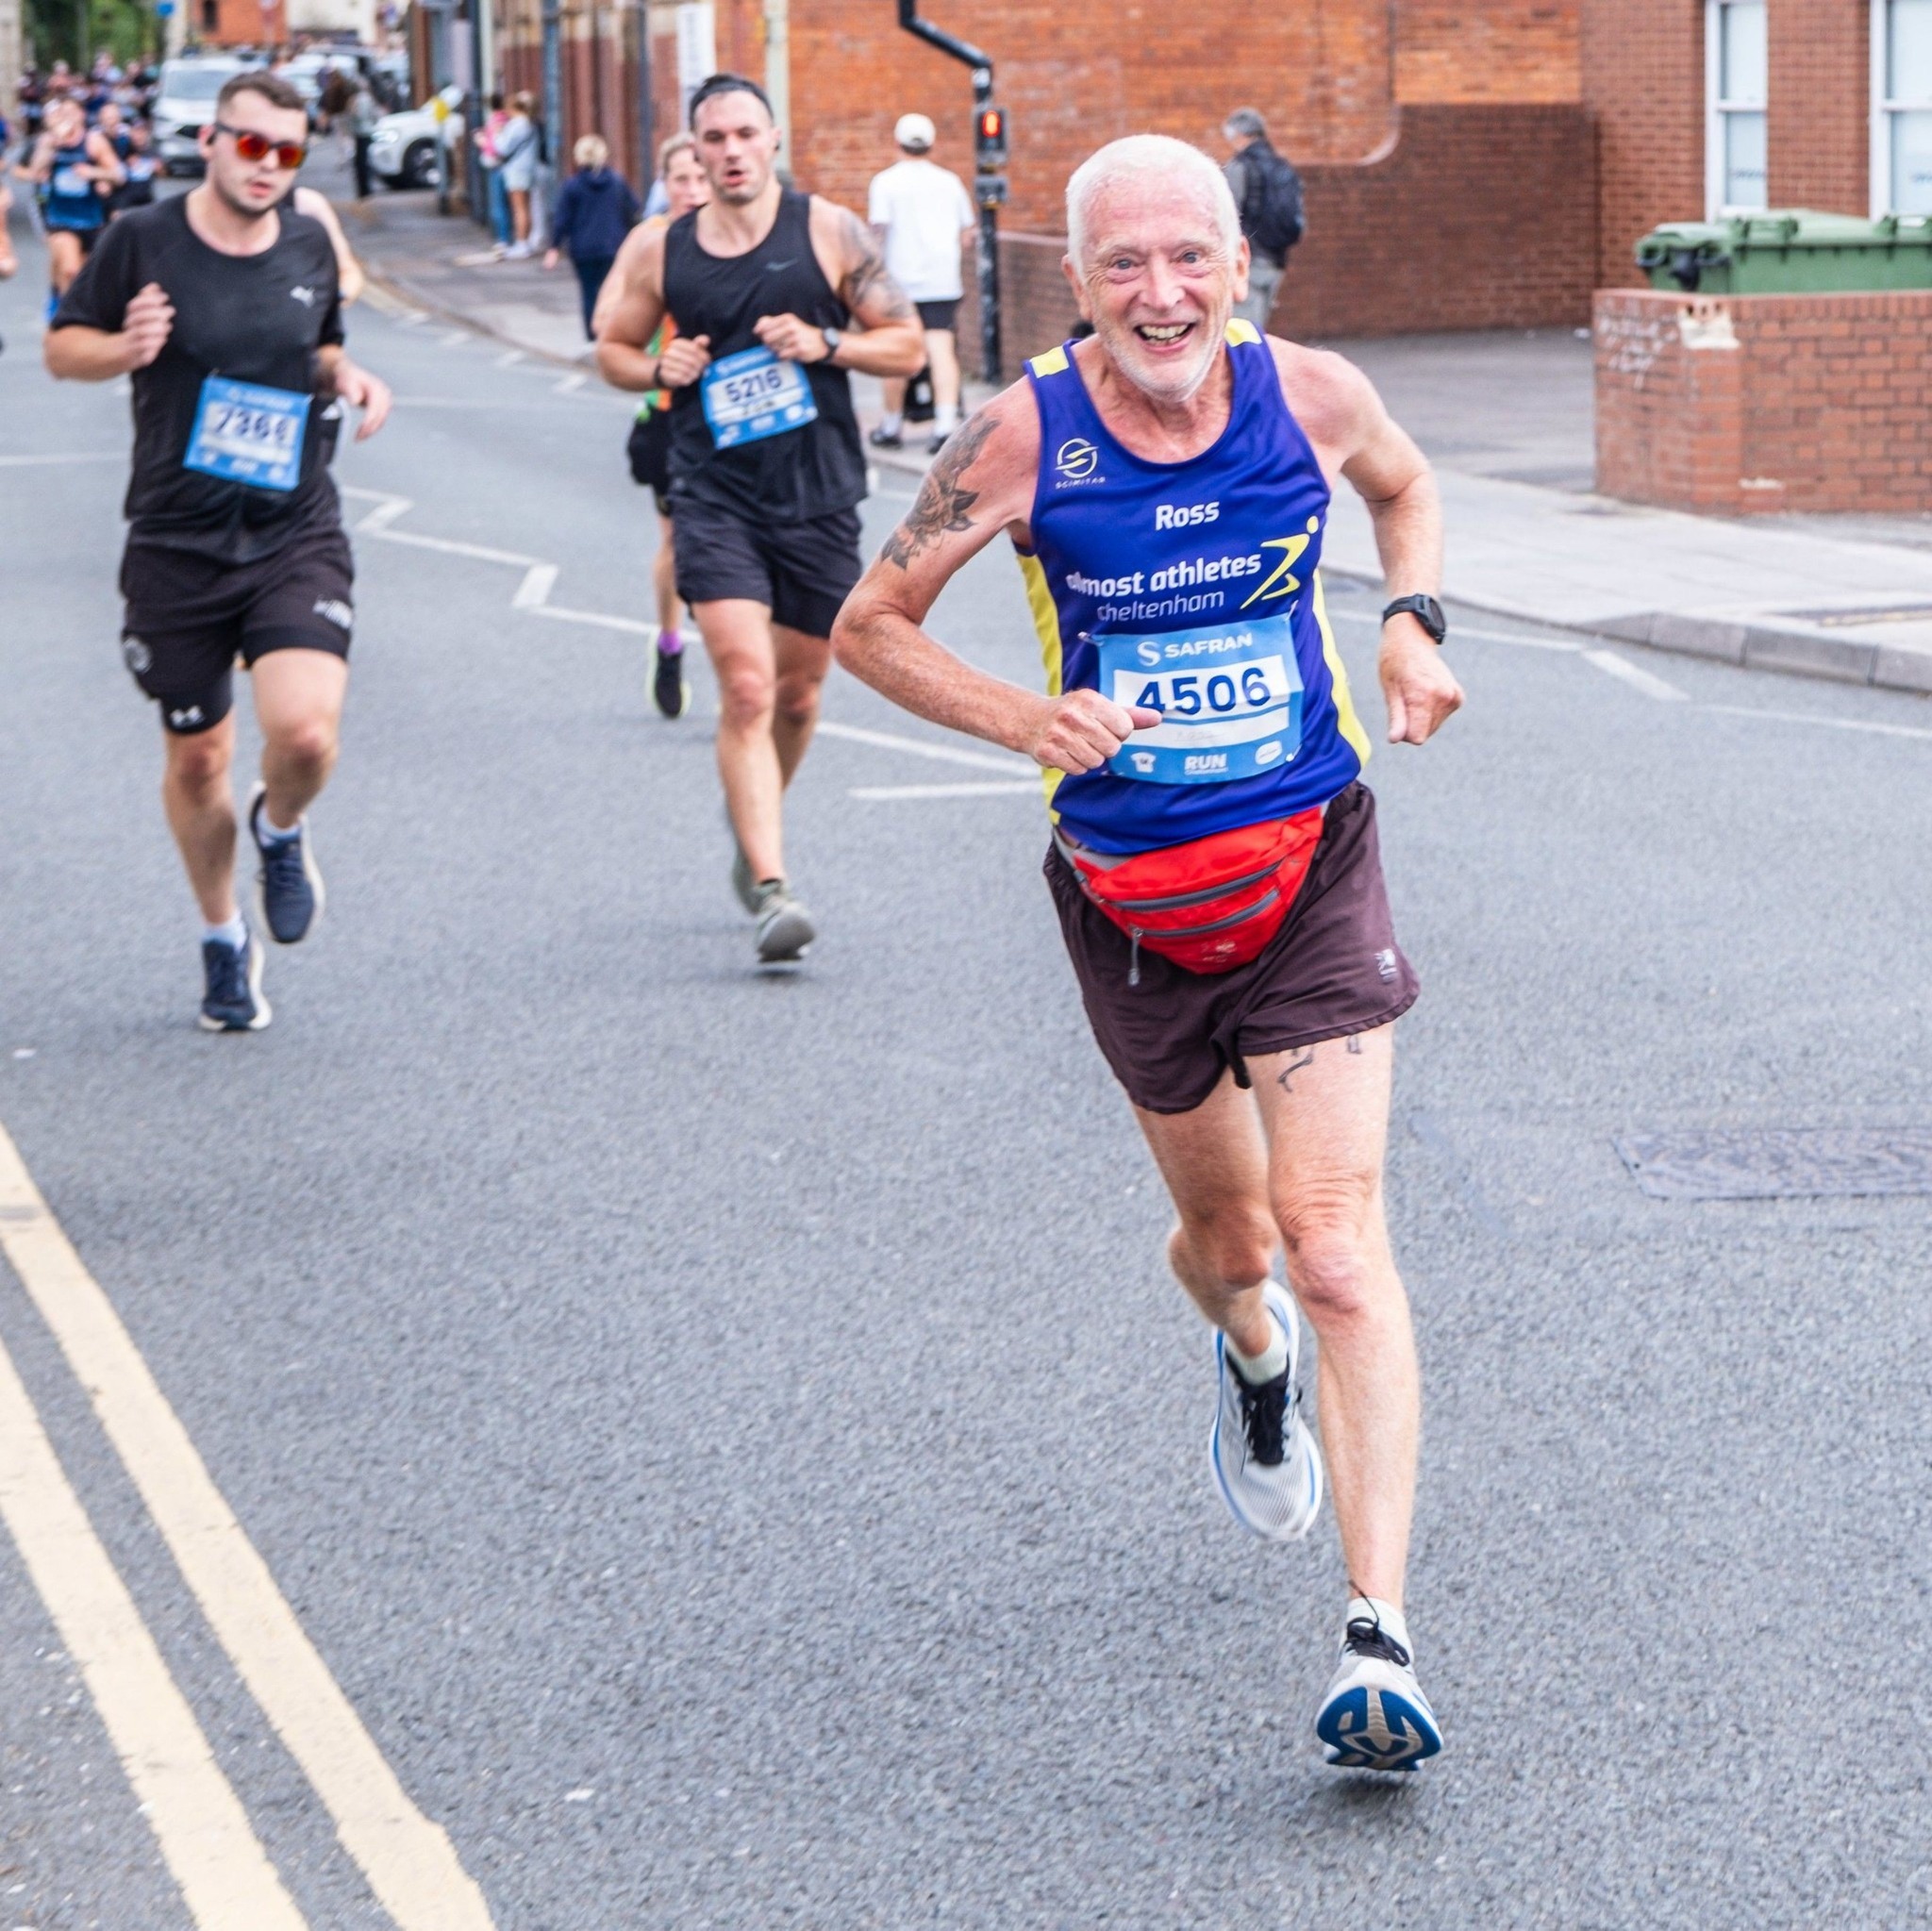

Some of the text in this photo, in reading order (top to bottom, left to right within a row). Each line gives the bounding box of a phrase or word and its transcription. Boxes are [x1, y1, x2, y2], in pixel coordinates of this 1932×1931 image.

[725, 368, 782, 403] 5216
[1155, 501, 1220, 531] Ross
[1150, 554, 1261, 591] athletes
[1097, 591, 1224, 622] cheltenham
[1164, 633, 1254, 658] SAFRAN
[1135, 667, 1271, 715] 4506
[1184, 753, 1227, 771] RUN
